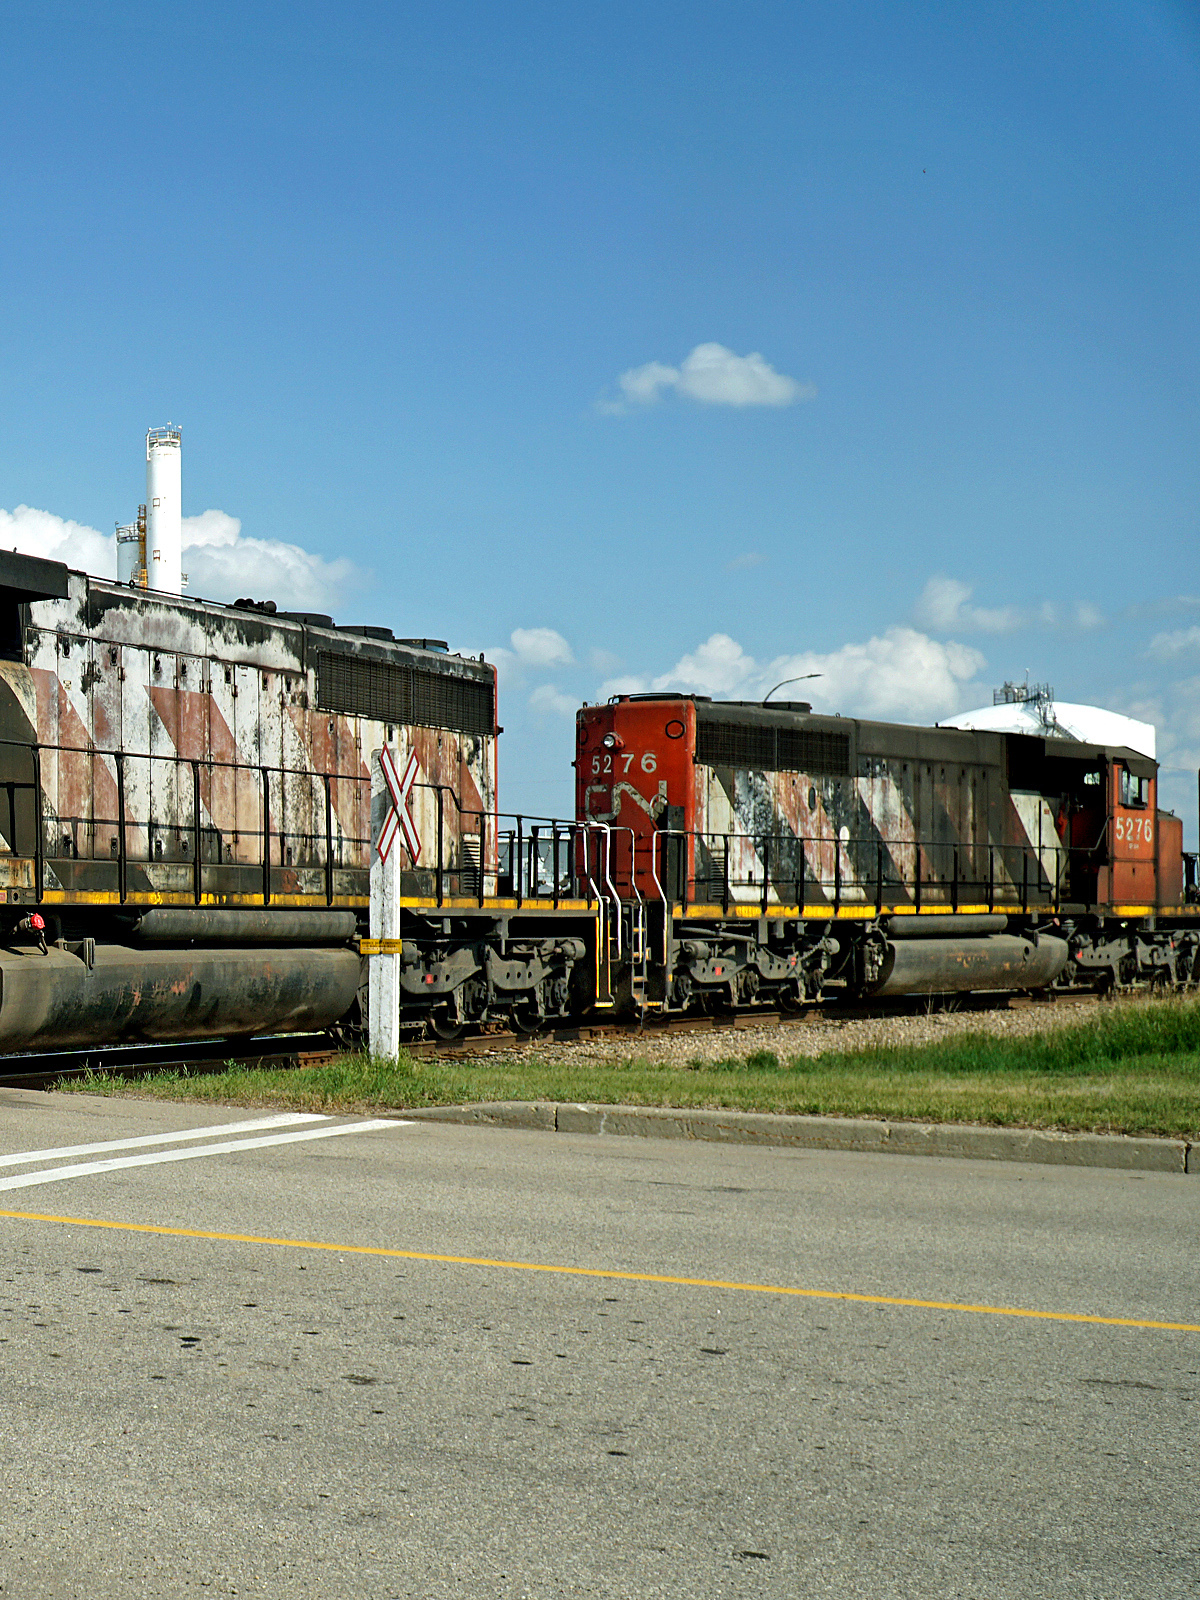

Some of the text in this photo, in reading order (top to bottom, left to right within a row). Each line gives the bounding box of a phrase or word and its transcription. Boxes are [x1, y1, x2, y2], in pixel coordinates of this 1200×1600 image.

[591, 753, 657, 774] 5276
[584, 780, 667, 822] CN
[1116, 816, 1152, 842] 5276
